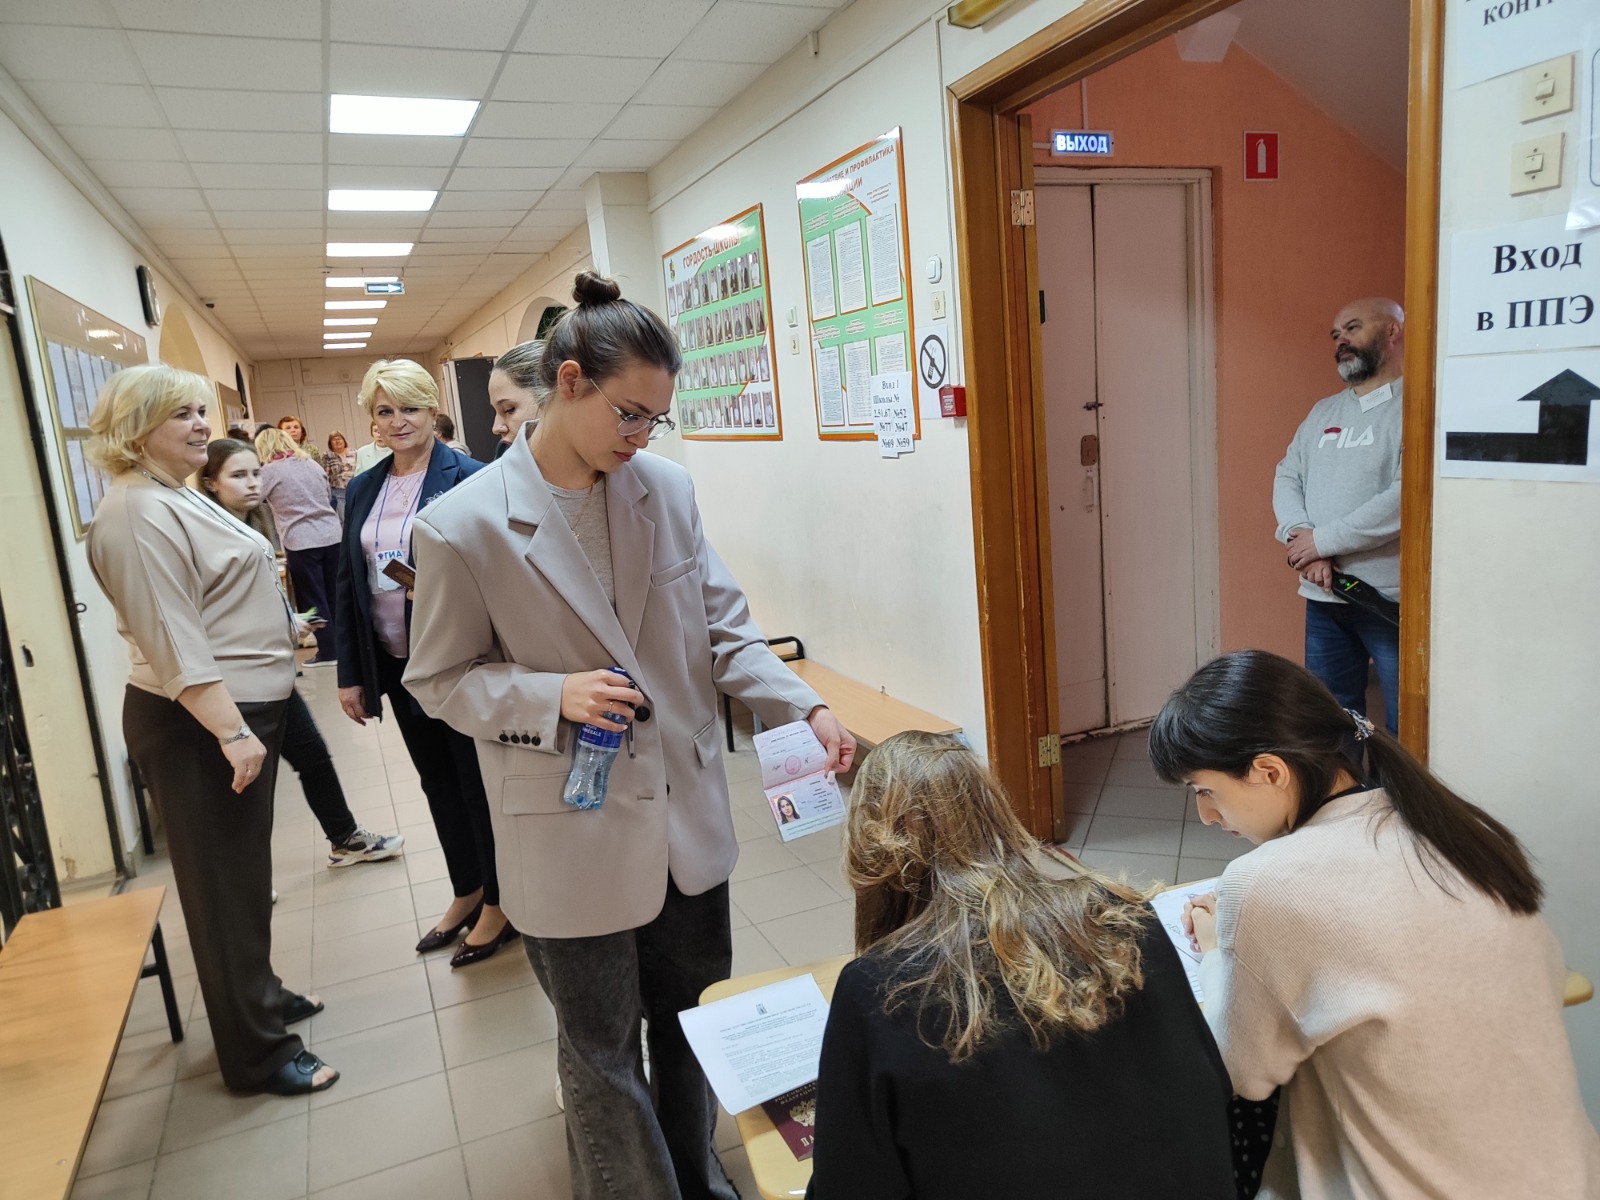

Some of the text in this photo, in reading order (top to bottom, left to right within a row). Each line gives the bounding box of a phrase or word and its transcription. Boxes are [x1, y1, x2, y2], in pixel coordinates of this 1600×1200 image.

[1056, 135, 1108, 154] ВЫХОД
[850, 144, 895, 174] ПРОФИЛАКТИКА
[682, 245, 713, 270] ГОРДОСТЬ
[1492, 242, 1583, 275] Вход
[1476, 294, 1594, 331] в ППЭ
[873, 395, 893, 404] Школы
[893, 408, 907, 418] №52
[879, 421, 909, 432] №77 №47
[1318, 425, 1374, 448] FILA
[384, 550, 403, 560] ГИА
